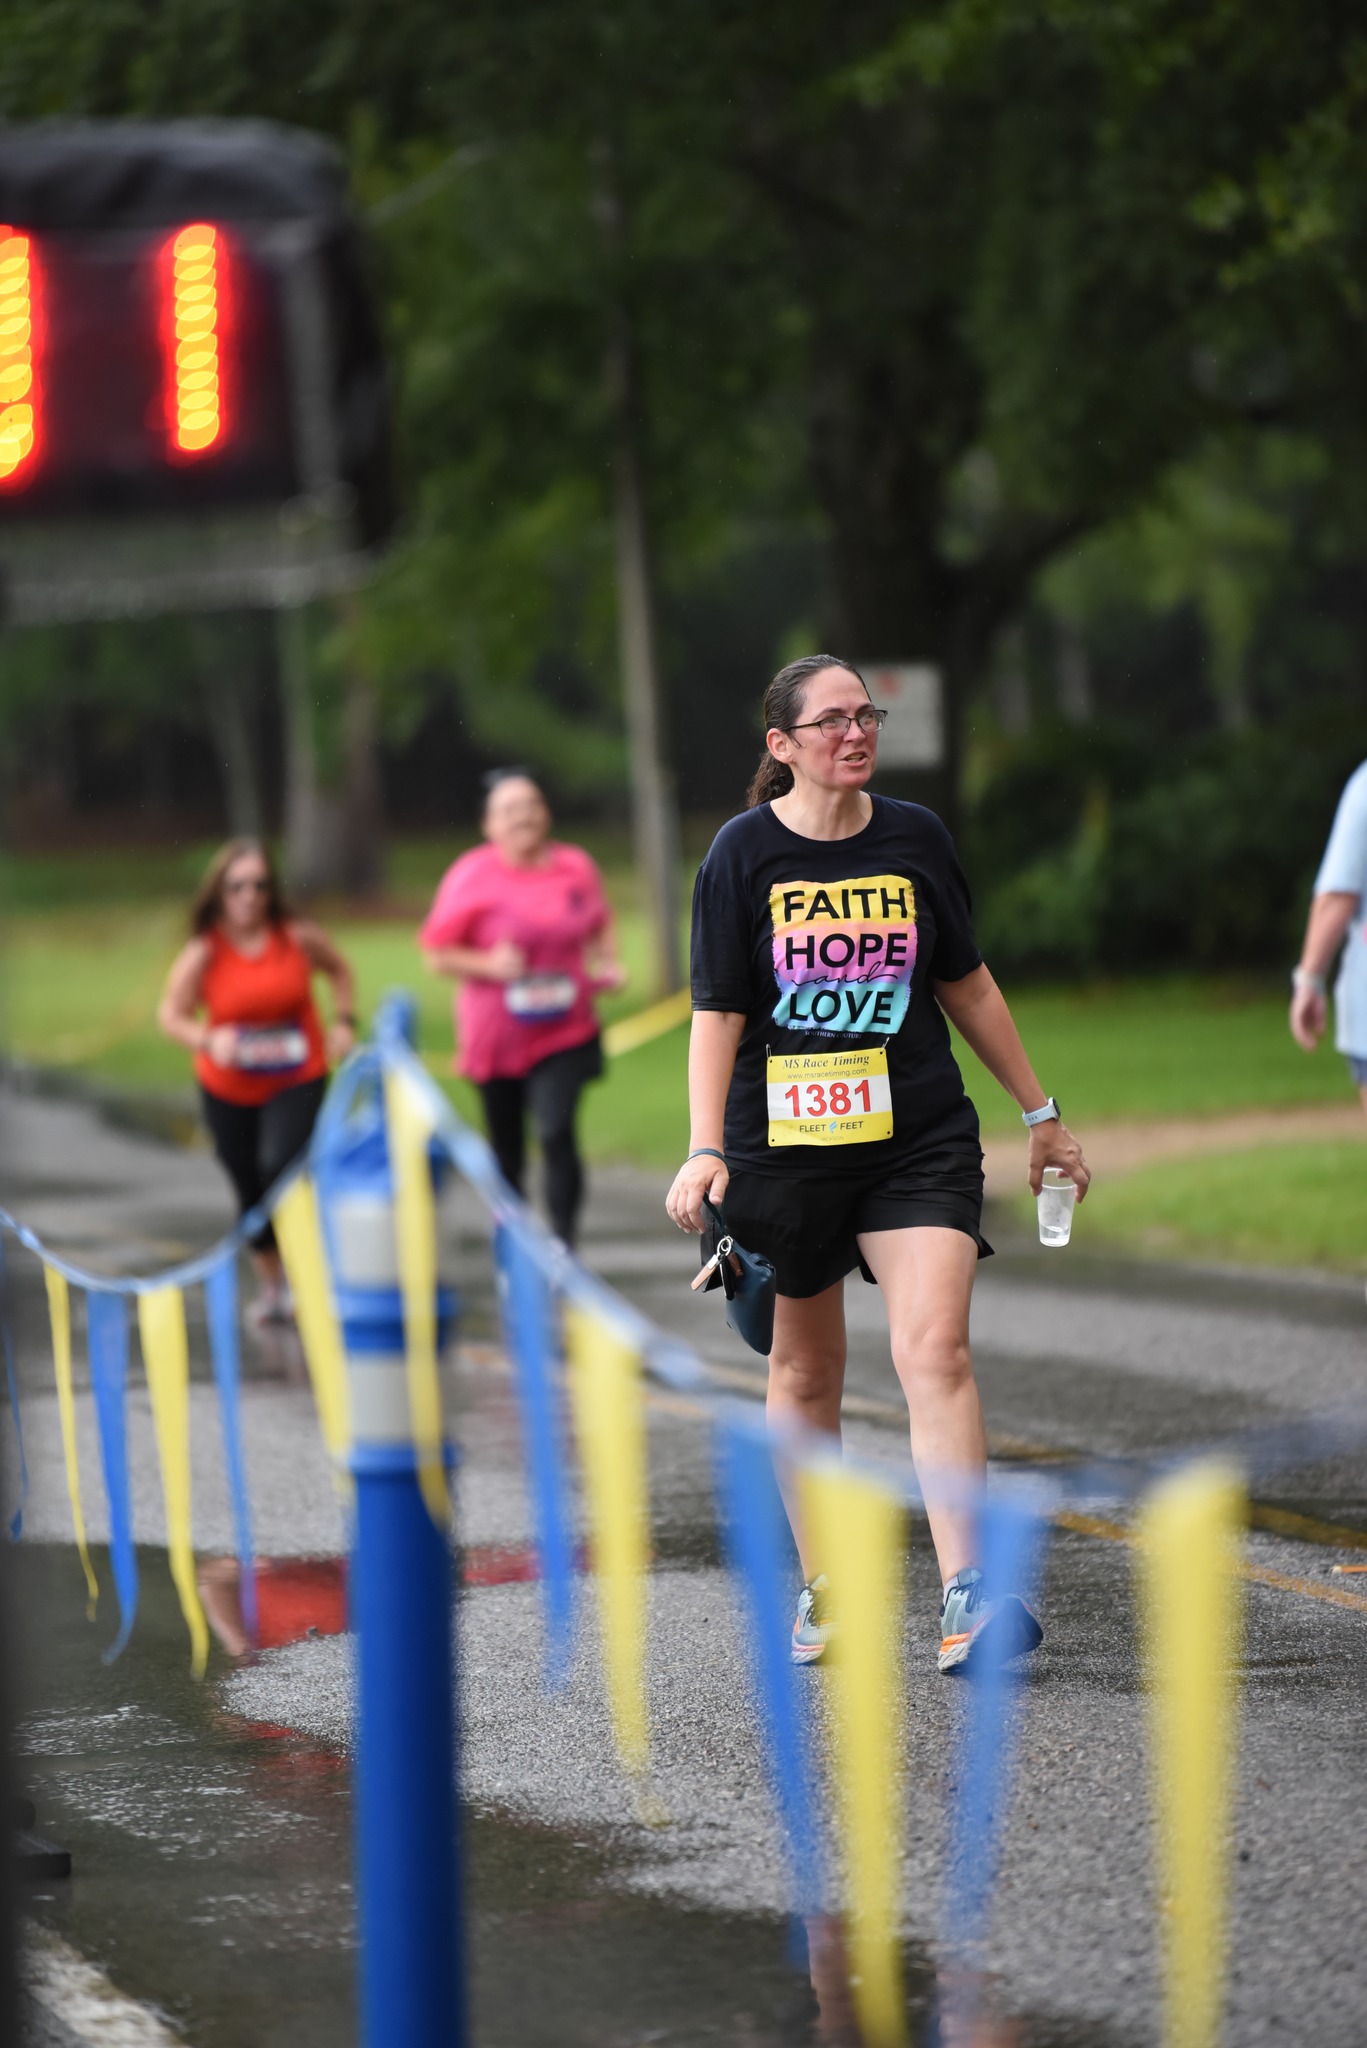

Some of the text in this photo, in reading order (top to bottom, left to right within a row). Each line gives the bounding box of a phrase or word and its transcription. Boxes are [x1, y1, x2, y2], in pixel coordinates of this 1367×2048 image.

[783, 888, 908, 922] FAITH
[785, 933, 908, 970] HOPE
[791, 961, 898, 986] and
[789, 989, 894, 1025] LOVE
[783, 1054, 870, 1069] MS Race Timing
[787, 1068, 867, 1079] www.msracetiming.com
[785, 1079, 871, 1118] 1381
[799, 1120, 864, 1133] FLEET FEET
